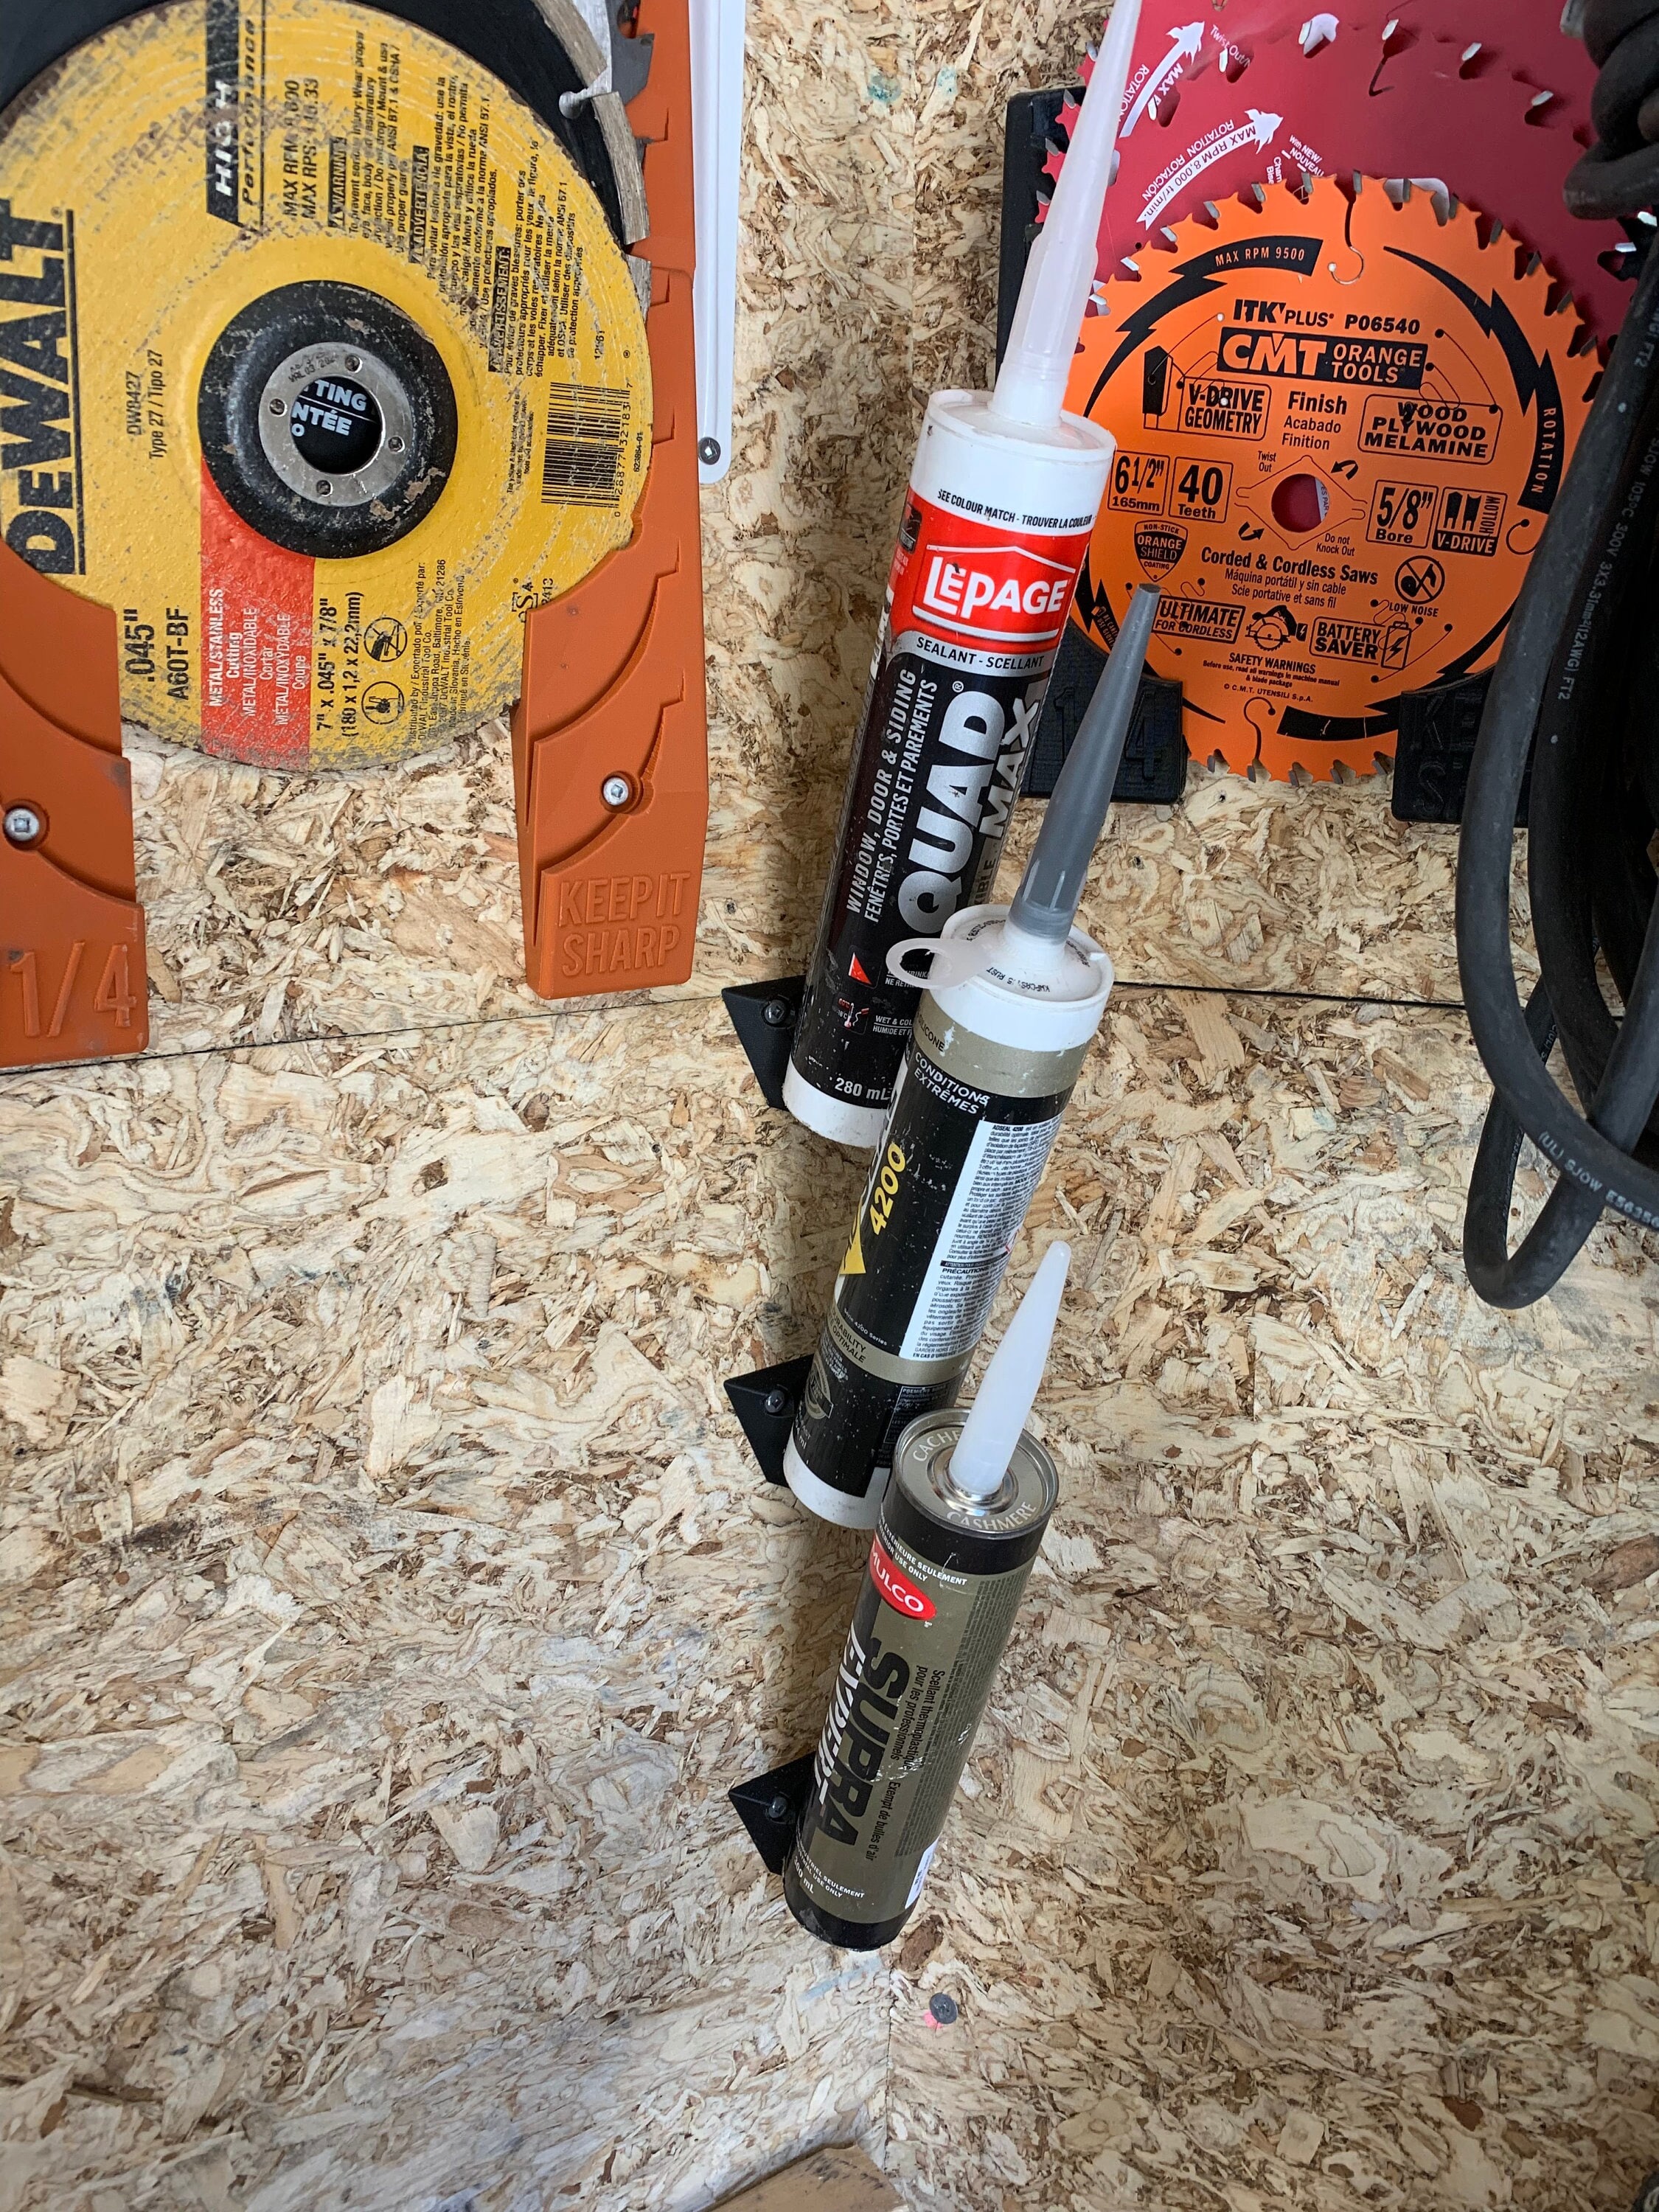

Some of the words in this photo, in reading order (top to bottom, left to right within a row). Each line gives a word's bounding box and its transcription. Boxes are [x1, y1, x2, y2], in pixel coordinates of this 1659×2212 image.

[1186, 119, 1234, 157] ROTATION
[1228, 125, 1256, 148] MAX
[1203, 140, 1228, 162] RPM
[1290, 147, 1325, 177] NOUVEAU
[1142, 155, 1186, 201] ROTACIÓN
[1174, 159, 1201, 187] 8,000
[1214, 249, 1239, 268] MAX
[1245, 245, 1269, 261] RPM
[1275, 246, 1304, 261] 9500
[1345, 314, 1420, 334] P06540
[147, 349, 162, 366] 27
[1223, 333, 1327, 376] CMT
[1333, 343, 1423, 367] ORANGE
[147, 370, 165, 397] Tipo
[1332, 361, 1399, 383] TOOLS
[123, 370, 144, 435] DW8427
[1187, 384, 1265, 412] V-DRIVE
[1287, 391, 1348, 414] Finish
[1397, 402, 1467, 422] WOOD
[148, 410, 164, 426] 27
[1184, 408, 1262, 434] GEOMETRY
[1283, 415, 1341, 433] Acabado
[1371, 417, 1486, 441] PLYWOOD
[148, 431, 167, 459] Type
[1281, 433, 1330, 450] Finition
[1363, 432, 1488, 458] MELAMINE
[1533, 407, 1557, 494] ROTATION
[1257, 451, 1276, 462] Twist
[1258, 462, 1272, 472] Out
[1177, 463, 1224, 506] 40
[937, 489, 951, 501] SEE
[949, 494, 984, 515] COLOUR
[984, 505, 1016, 523] MATCH
[1021, 514, 1058, 529] TROUVER
[1059, 517, 1068, 529] LA
[1112, 495, 1160, 511] 165mm
[1177, 504, 1216, 519] Teeth
[1479, 495, 1500, 535] HOLLOW
[1137, 535, 1182, 549] ORANGE
[1144, 522, 1179, 534] NON-STICK
[1325, 533, 1335, 543] Do
[1338, 535, 1350, 544] not
[1375, 528, 1413, 543] Bore
[1140, 546, 1177, 560] SHIELD
[1316, 543, 1338, 553] Knock
[1342, 546, 1354, 556] Out
[1436, 533, 1494, 554] V-DRIVE
[1143, 561, 1169, 569] COATING
[1200, 546, 1251, 568] Corded
[1256, 554, 1267, 570] &
[1273, 556, 1335, 579] Cordless
[1340, 565, 1378, 585] Saws
[1225, 568, 1262, 583] Máquina
[1265, 574, 1297, 588] portátil
[1300, 580, 1304, 591] y
[1307, 581, 1319, 591] sin
[1322, 583, 1346, 594] cable
[1231, 584, 1250, 596] Scie
[1253, 588, 1290, 602] portative
[1294, 594, 1301, 602] et
[1304, 596, 1325, 606] sans
[1328, 597, 1336, 608] fil
[1388, 602, 1408, 613] LOW
[1411, 605, 1439, 617] NOISE
[319, 598, 336, 631] 7/8"
[343, 591, 364, 653] 22,2mm)
[433, 606, 443, 647] Baltimore,
[1159, 599, 1239, 627] ULTIMATE
[1155, 619, 1175, 630] FOR
[1178, 622, 1232, 639] CORDLESS
[1316, 622, 1381, 644] BATTERY
[122, 608, 156, 681] .045"
[164, 608, 189, 700] A60T-BF
[206, 588, 226, 706] METAL/STAINLESS
[226, 631, 242, 678] Cutting
[916, 637, 976, 664] SEALANT
[987, 655, 1044, 676] SCELLANT
[1314, 636, 1378, 659] SAVER
[240, 608, 260, 716] METAL/INOXIDABLE
[260, 646, 274, 680] Cortar
[272, 613, 292, 724] MÉTAL/INOXYDABLE
[292, 655, 310, 689] Coupe
[317, 653, 335, 693] .045"
[431, 650, 441, 673] Road,
[1228, 651, 1262, 666] SAFETY
[1264, 657, 1315, 674] WARNINGS
[342, 669, 361, 691] 1,2
[1252, 675, 1267, 684] blade
[1269, 678, 1293, 687] package
[1258, 669, 1284, 679] warnings
[1292, 673, 1316, 682] machine
[1318, 677, 1340, 686] manual
[1557, 677, 1576, 700] FT2
[1231, 685, 1254, 693] C.M.T.
[1257, 689, 1290, 698] UTENSILI
[1292, 694, 1313, 702] S.p.A.
[902, 680, 936, 772] PAREMENTS
[979, 696, 1044, 838] MAX
[847, 830, 880, 914] WINDOW,
[868, 769, 891, 824] DOOR
[882, 746, 897, 765] &
[892, 669, 916, 744] SIDING
[896, 775, 913, 793] ET
[880, 794, 910, 850] PORTES
[899, 691, 1004, 933] QUAD
[558, 875, 653, 927] KEEP
[655, 872, 691, 917] IT
[864, 850, 897, 922] FENÊTRES,
[562, 923, 681, 976] SHARP
[10, 942, 137, 1038] 1/4
[872, 1024, 897, 1035] HUMIDE
[874, 1015, 891, 1023] WET
[834, 1077, 863, 1096] 280
[866, 1085, 891, 1101] mL
[914, 1068, 978, 1114] EXTRÊMES
[915, 1053, 990, 1105] CONDITIONS
[1564, 1158, 1603, 1192] SJOW
[868, 1144, 905, 1236] 4200
[832, 1328, 866, 1363] OPTIMALE
[947, 1501, 1036, 1531] CASHMERE
[883, 1523, 917, 1565] EXTÉRIEURE
[917, 1559, 967, 1585] SEULEMENT
[893, 1553, 907, 1568] USE
[908, 1563, 927, 1581] ONLY
[871, 1548, 923, 1612] MULCO
[916, 1665, 928, 1687] pour
[929, 1669, 945, 1705] Scellant
[908, 1688, 922, 1701] les
[818, 1627, 866, 1804] EXPERT
[830, 1638, 910, 1846] SUPRA
[891, 1701, 917, 1761] professionnels
[906, 1704, 933, 1770] thermoplastique
[886, 1781, 900, 1810] Exempt
[879, 1810, 891, 1820] de
[872, 1821, 886, 1843] bulles
[866, 1843, 878, 1860] d'air
[824, 1877, 864, 1898] SEULEMENT
